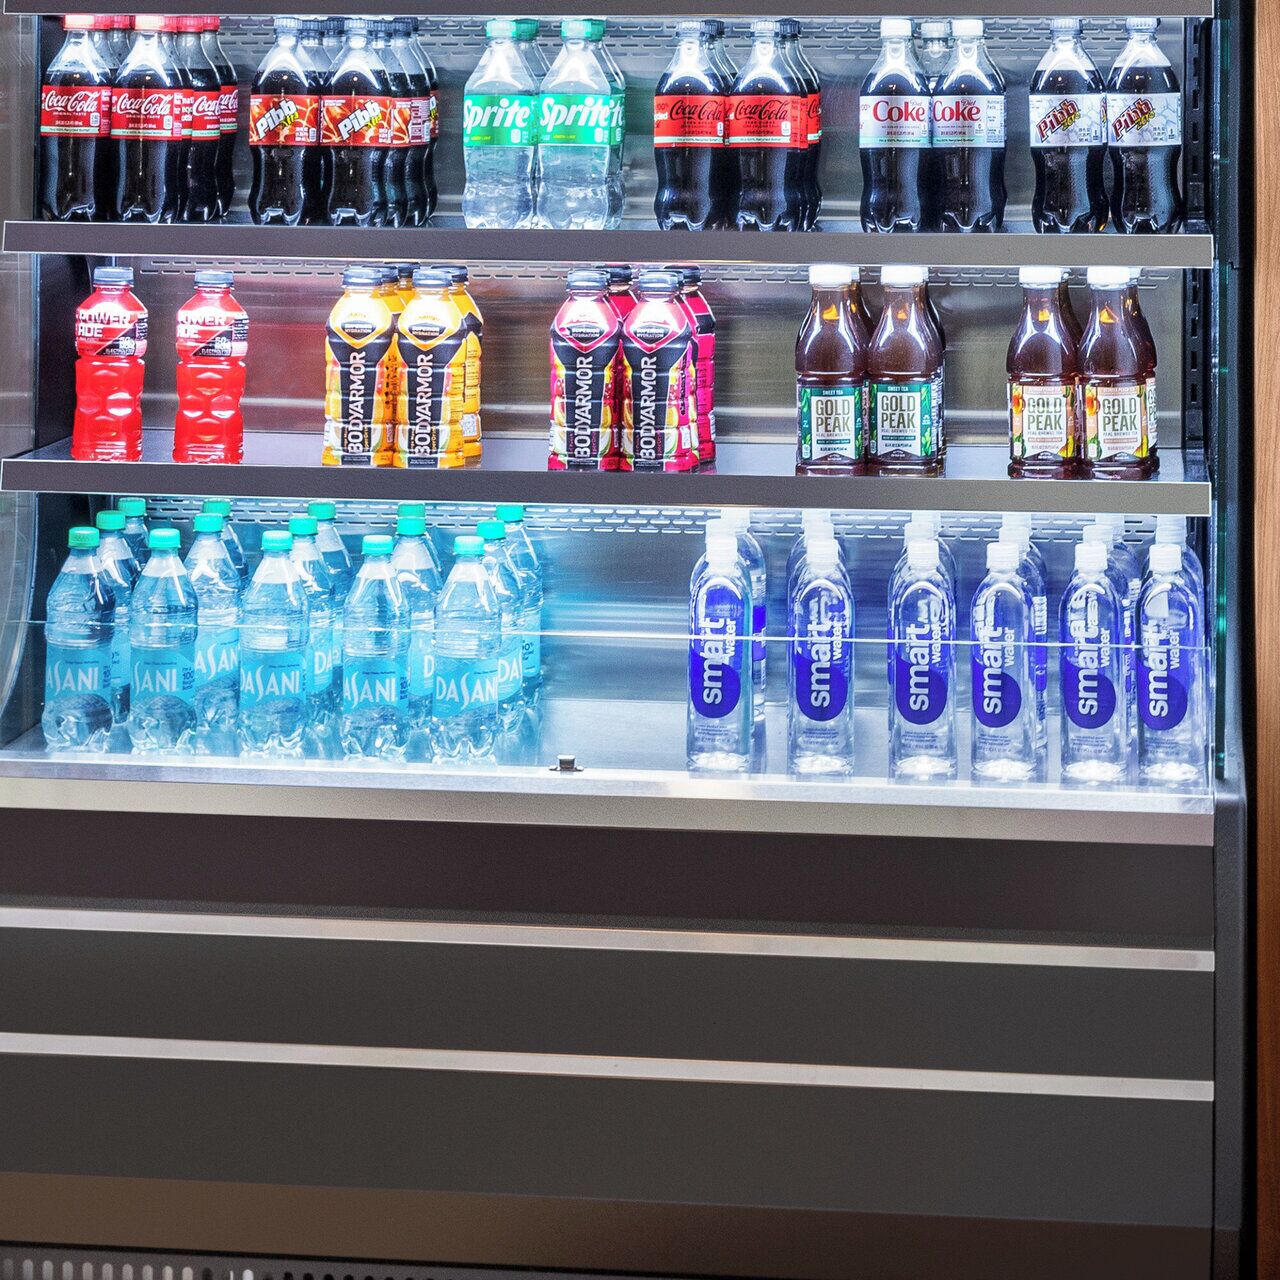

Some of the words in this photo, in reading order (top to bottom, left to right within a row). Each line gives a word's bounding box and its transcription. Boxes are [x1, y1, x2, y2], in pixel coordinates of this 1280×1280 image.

[45, 89, 99, 113] Coca-Cola
[117, 93, 172, 115] Coca-Cola
[255, 99, 298, 140] Pibb
[337, 100, 381, 141] Pibb
[463, 97, 530, 133] Sprite
[540, 96, 610, 133] Sprite
[734, 99, 788, 121] Coca-Cola
[872, 100, 926, 122] Coke
[932, 100, 981, 122] Coke
[1035, 97, 1080, 143] Pibb
[1111, 97, 1155, 142] Pibb
[347, 351, 366, 454] BODYARMOR
[414, 353, 434, 457] BODYARMOR
[574, 355, 593, 458] BODYARMOR
[639, 356, 658, 459] BODYARMOR
[815, 399, 851, 416] GOLD
[880, 395, 916, 412] GOLD
[881, 412, 916, 429] PEAK
[1027, 397, 1062, 414] GOLD
[1027, 414, 1063, 431] PEAK
[1102, 397, 1137, 414] GOLD
[815, 416, 851, 433] PEAK
[1102, 414, 1137, 432] PEAK
[724, 619, 737, 665] water
[832, 620, 843, 660] water
[931, 624, 941, 664] water
[1003, 627, 1015, 667] water
[1099, 627, 1110, 668] water
[1169, 628, 1180, 670] water
[700, 618, 725, 705] smart
[807, 620, 832, 708] smart
[905, 623, 930, 711] smart
[982, 625, 1003, 715] smart
[1077, 625, 1099, 716] smart
[1148, 622, 1168, 717] smart
